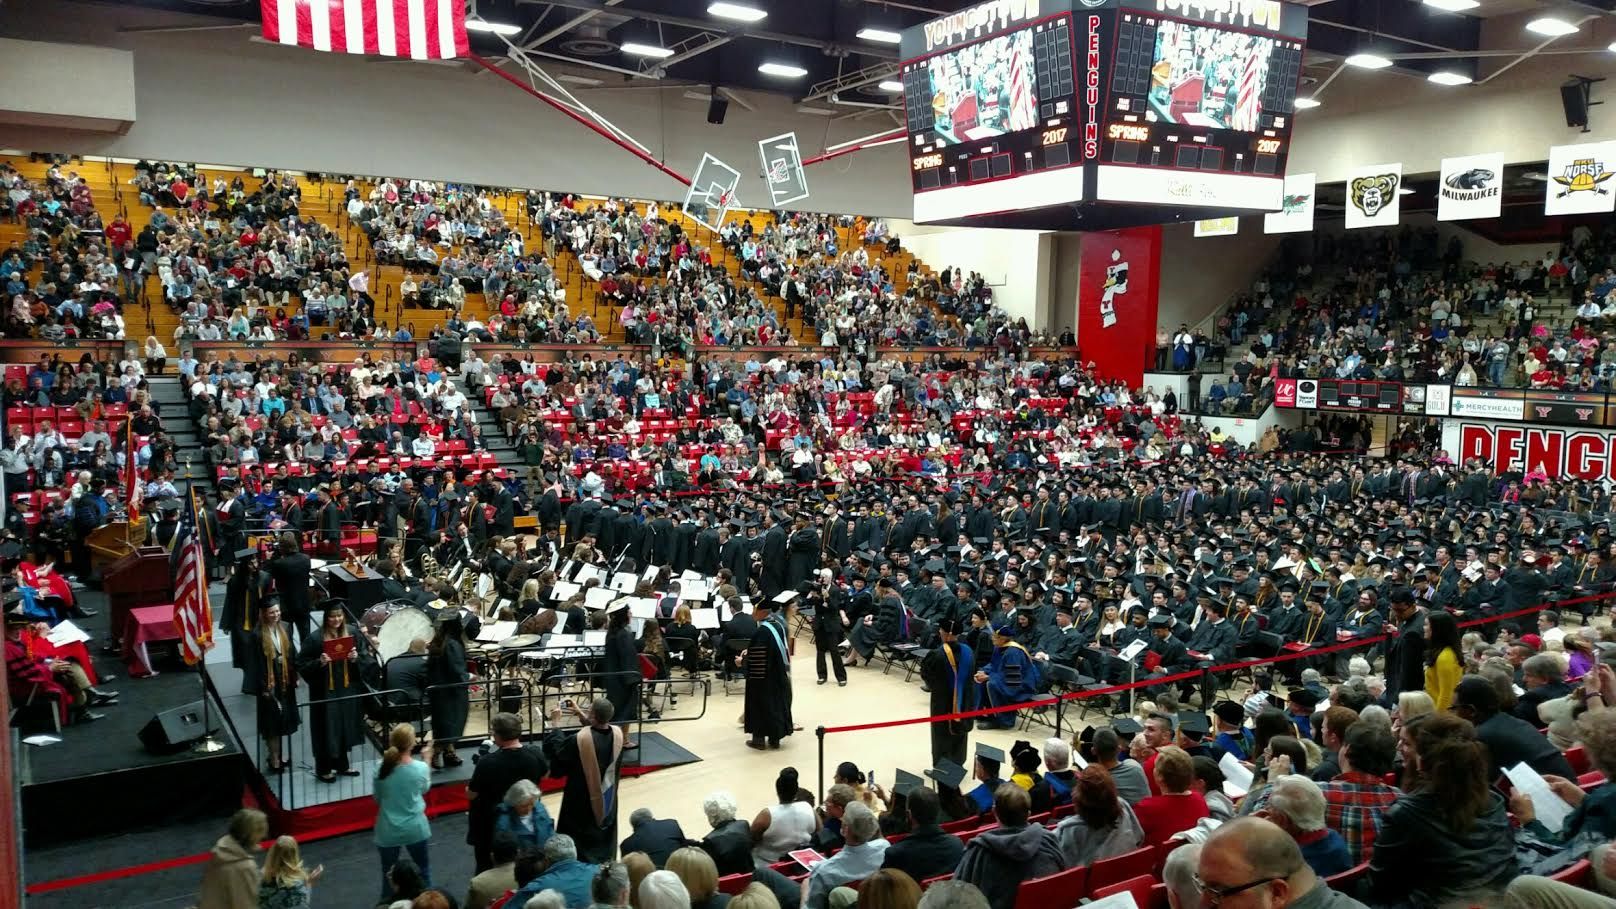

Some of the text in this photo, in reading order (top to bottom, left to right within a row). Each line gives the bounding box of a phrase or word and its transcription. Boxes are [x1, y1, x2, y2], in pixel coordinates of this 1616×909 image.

[1085, 15, 1100, 159] PENGUINS
[1042, 128, 1068, 145] 2017
[1109, 124, 1149, 141] SPRING
[1257, 140, 1281, 153] 2017
[913, 153, 943, 170] SPRING
[1565, 162, 1603, 177] NORSE
[1442, 187, 1498, 201] MILWAUKEE
[1466, 403, 1522, 413] MERCYHEALTH
[1460, 423, 1616, 484] PENG
